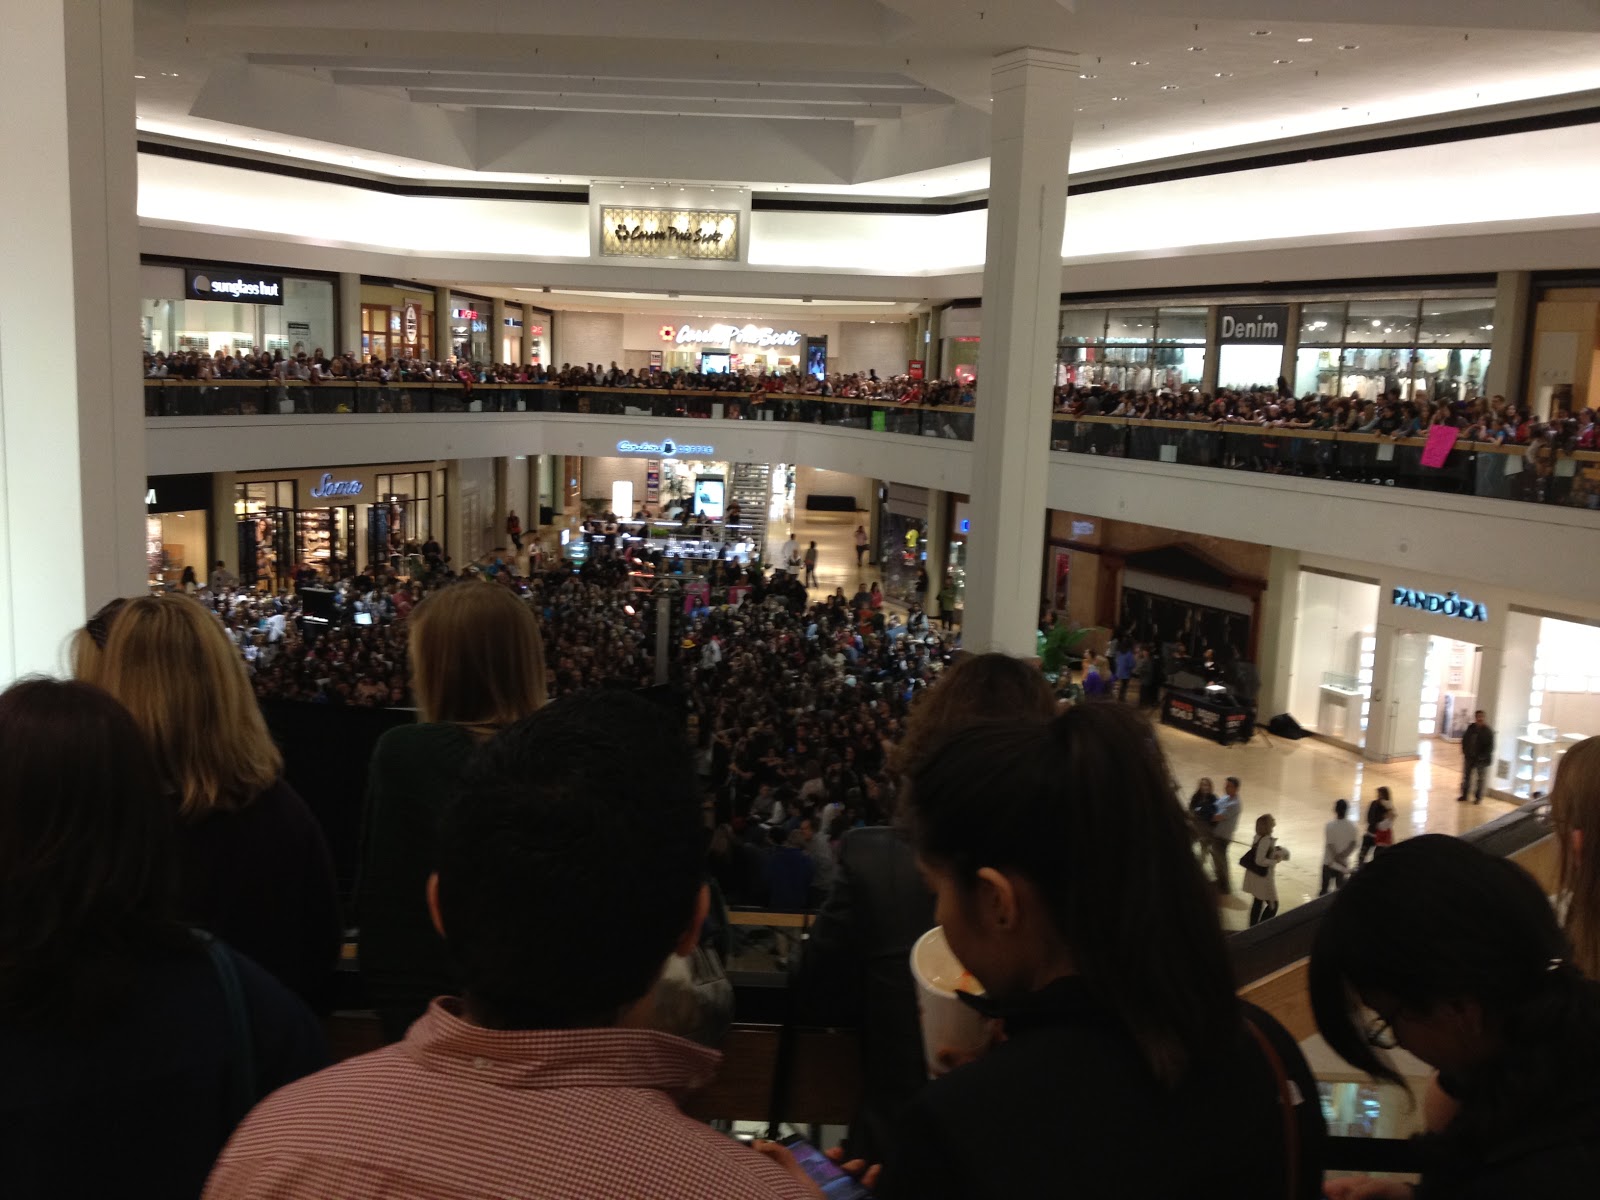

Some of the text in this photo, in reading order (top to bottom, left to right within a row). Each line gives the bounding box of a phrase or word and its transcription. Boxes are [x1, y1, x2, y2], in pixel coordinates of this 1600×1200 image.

[211, 279, 279, 298] sunglass hut
[1221, 314, 1279, 339] Denim
[310, 473, 364, 498] Soma
[1391, 586, 1488, 622] PANDORA
